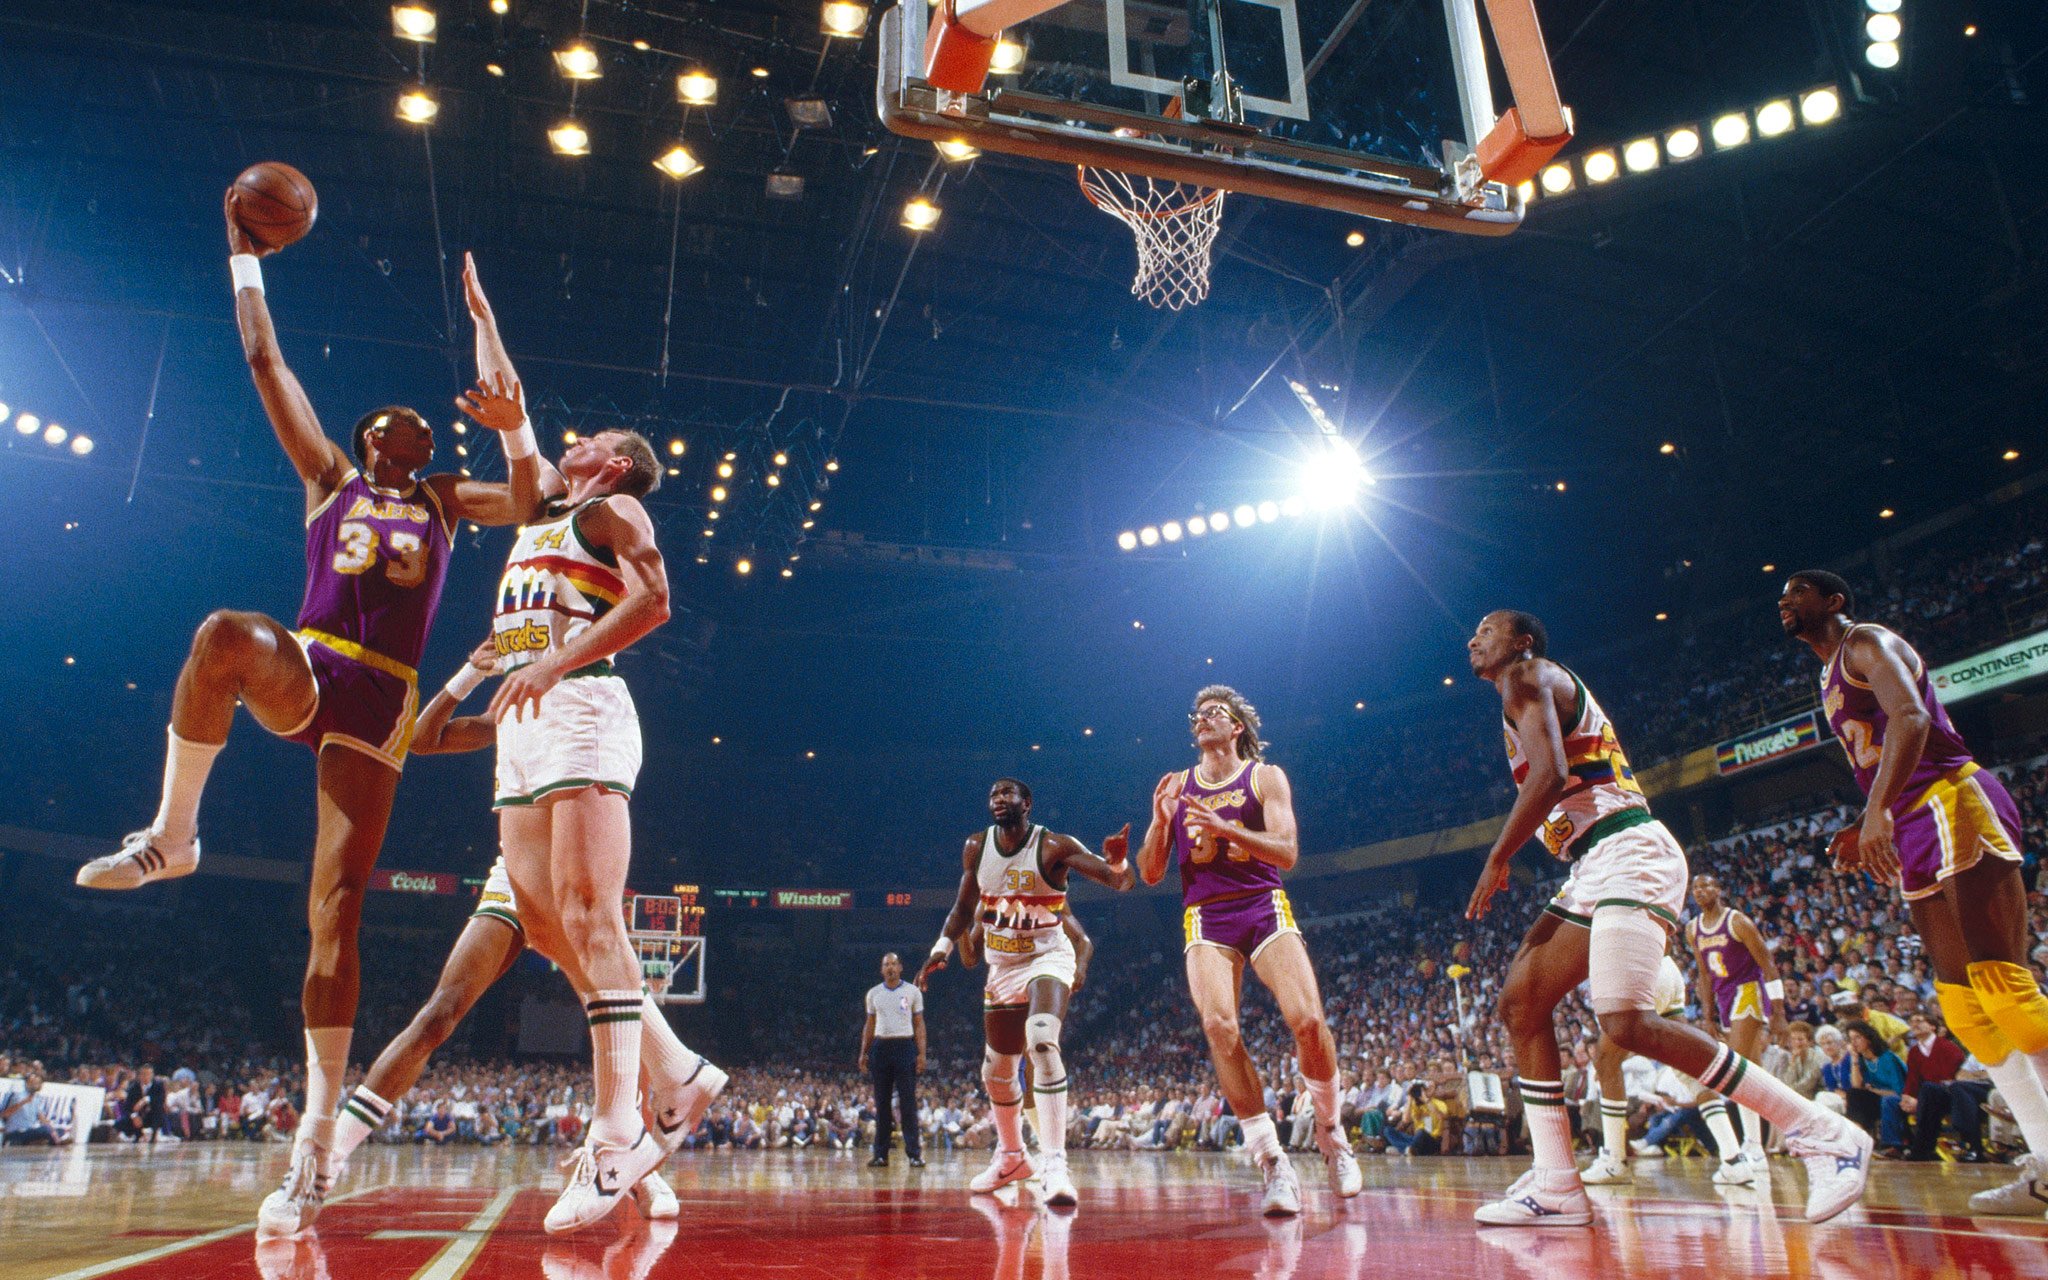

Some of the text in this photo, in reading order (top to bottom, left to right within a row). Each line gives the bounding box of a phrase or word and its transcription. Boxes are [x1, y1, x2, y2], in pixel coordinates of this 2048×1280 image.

[343, 494, 430, 523] LAKERS
[533, 525, 570, 551] 44
[332, 520, 429, 588] 33
[1838, 718, 1882, 769] 2
[1006, 870, 1036, 890] 33
[778, 891, 841, 905] Winston
[1708, 951, 1729, 977] 4
